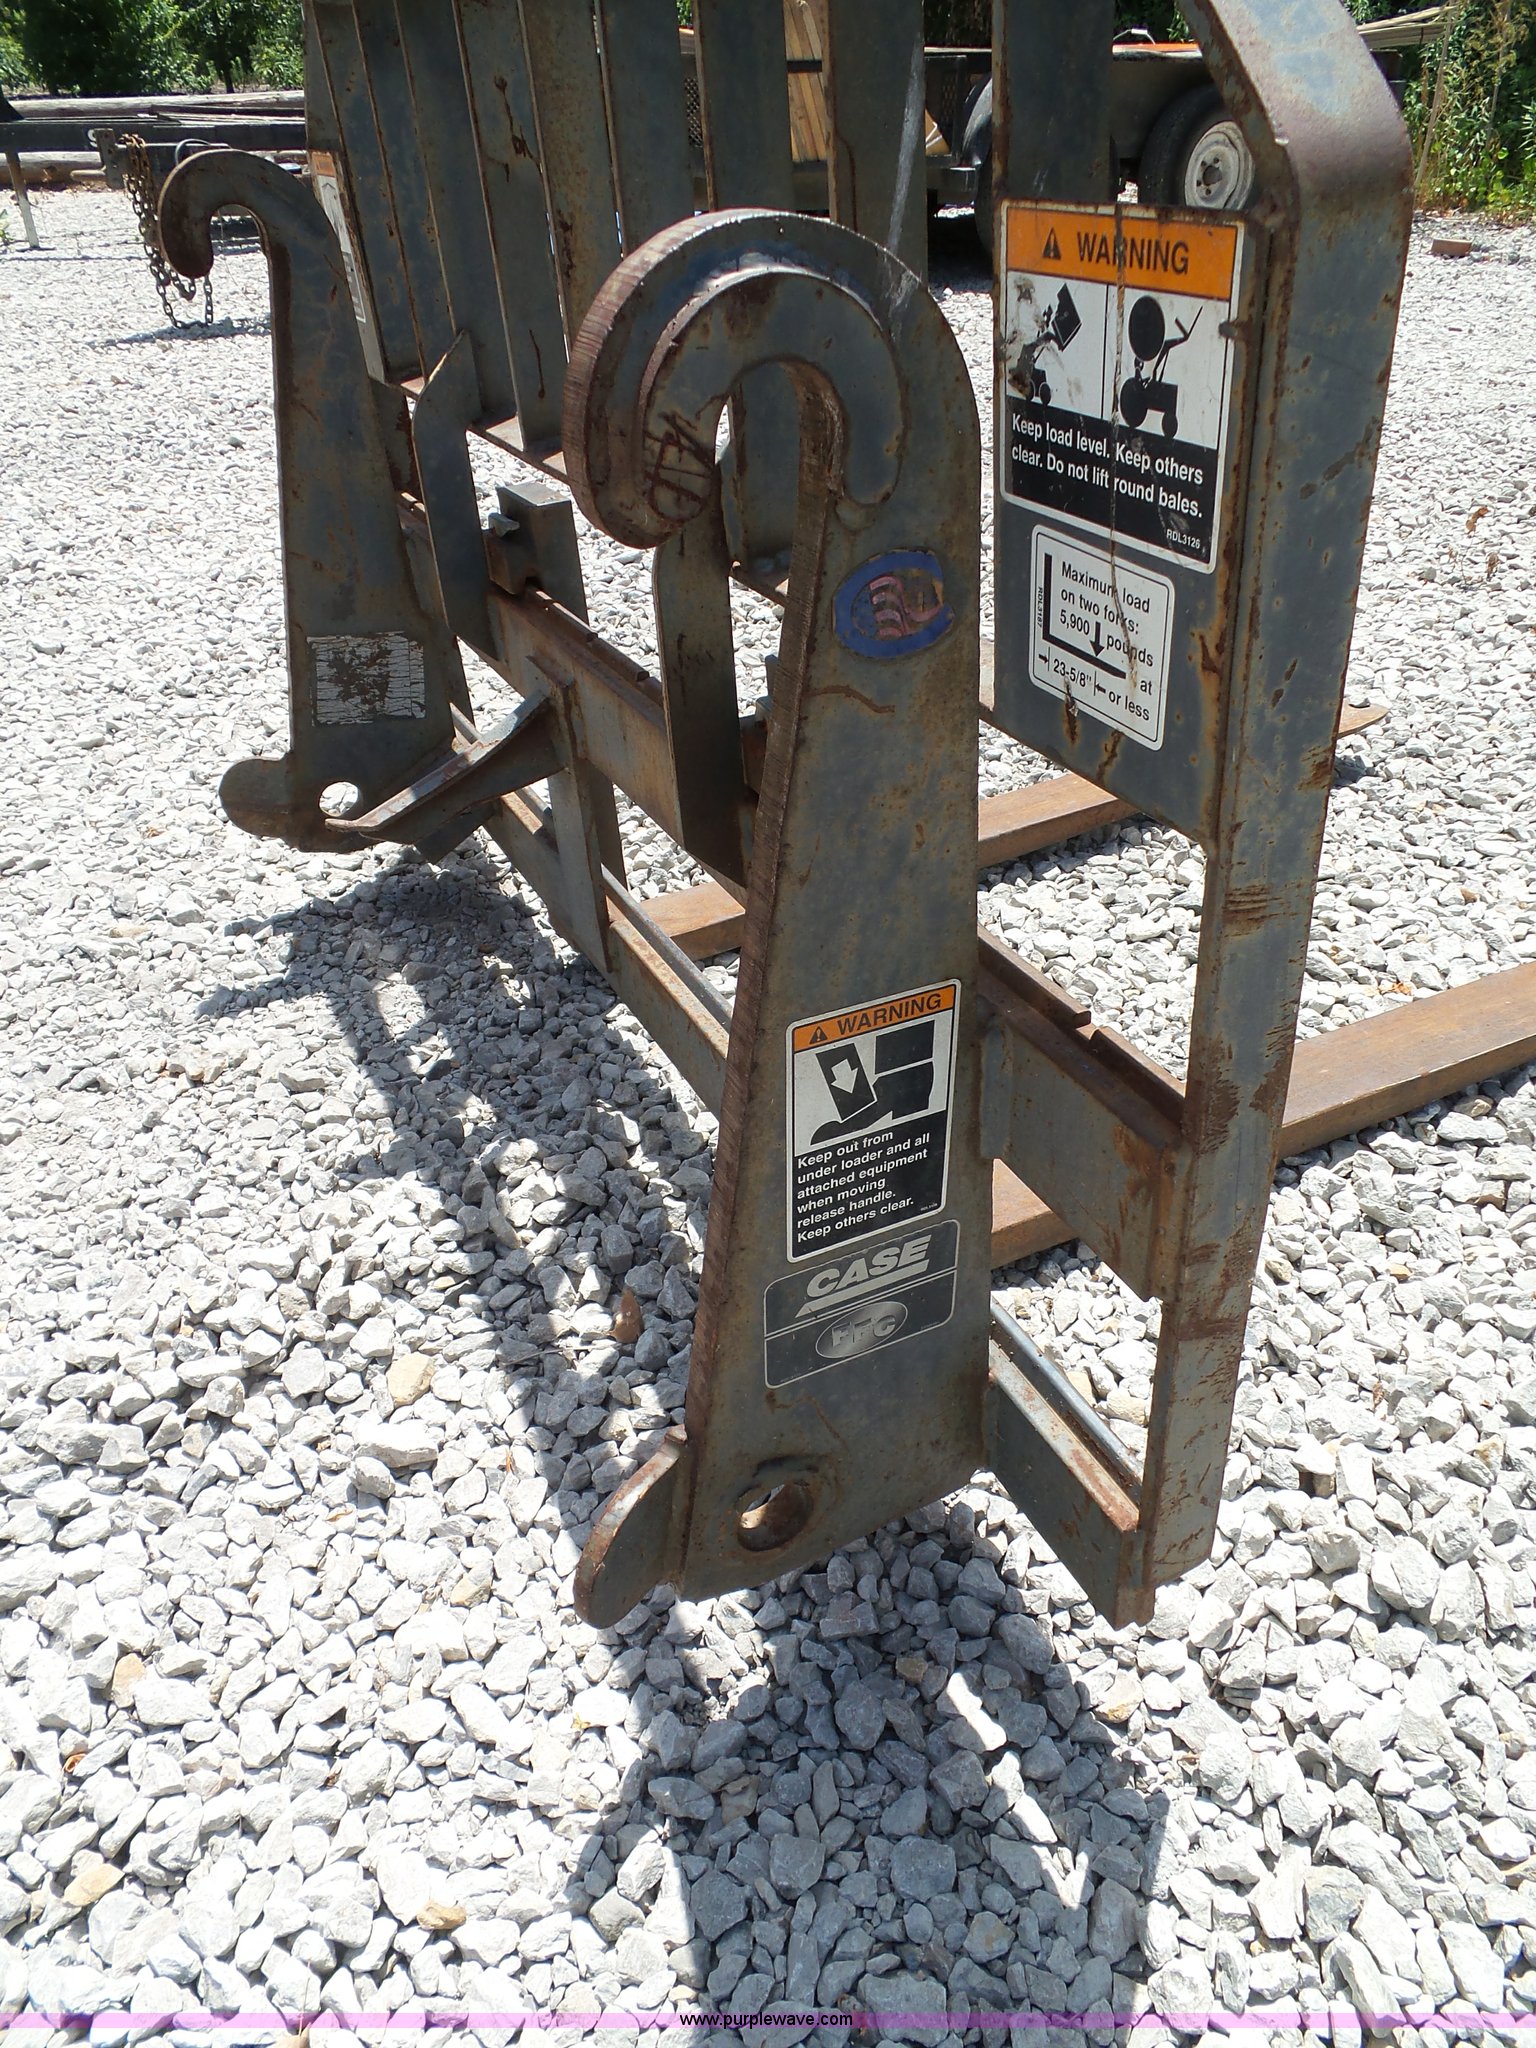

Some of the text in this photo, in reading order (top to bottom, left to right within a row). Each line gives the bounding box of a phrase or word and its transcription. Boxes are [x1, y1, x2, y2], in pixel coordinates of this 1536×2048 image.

[1076, 232, 1189, 275] WARNING
[1012, 412, 1203, 485] Keep load level. Keep others
[1012, 444, 1202, 518] clear. Do not lift round bales.
[1166, 528, 1201, 550] RDL3126
[1061, 561, 1150, 613] Maximum load
[1061, 588, 1075, 604] on
[1079, 593, 1100, 616] two
[1059, 609, 1154, 667] 5,900 pounds
[1053, 658, 1150, 721] 23-5/8" or less
[1140, 679, 1152, 696] at
[836, 993, 942, 1036] WARNING
[797, 1131, 893, 1169] Keep out from
[797, 1132, 930, 1184] under loader and all
[797, 1148, 928, 1199] attached equipment
[797, 1177, 886, 1214] when moving
[797, 1204, 845, 1228] release
[849, 1190, 896, 1211] handle.
[797, 1224, 831, 1243] Keep
[835, 1208, 876, 1230] others
[880, 1196, 914, 1215] clear.
[806, 1234, 932, 1298] CASE
